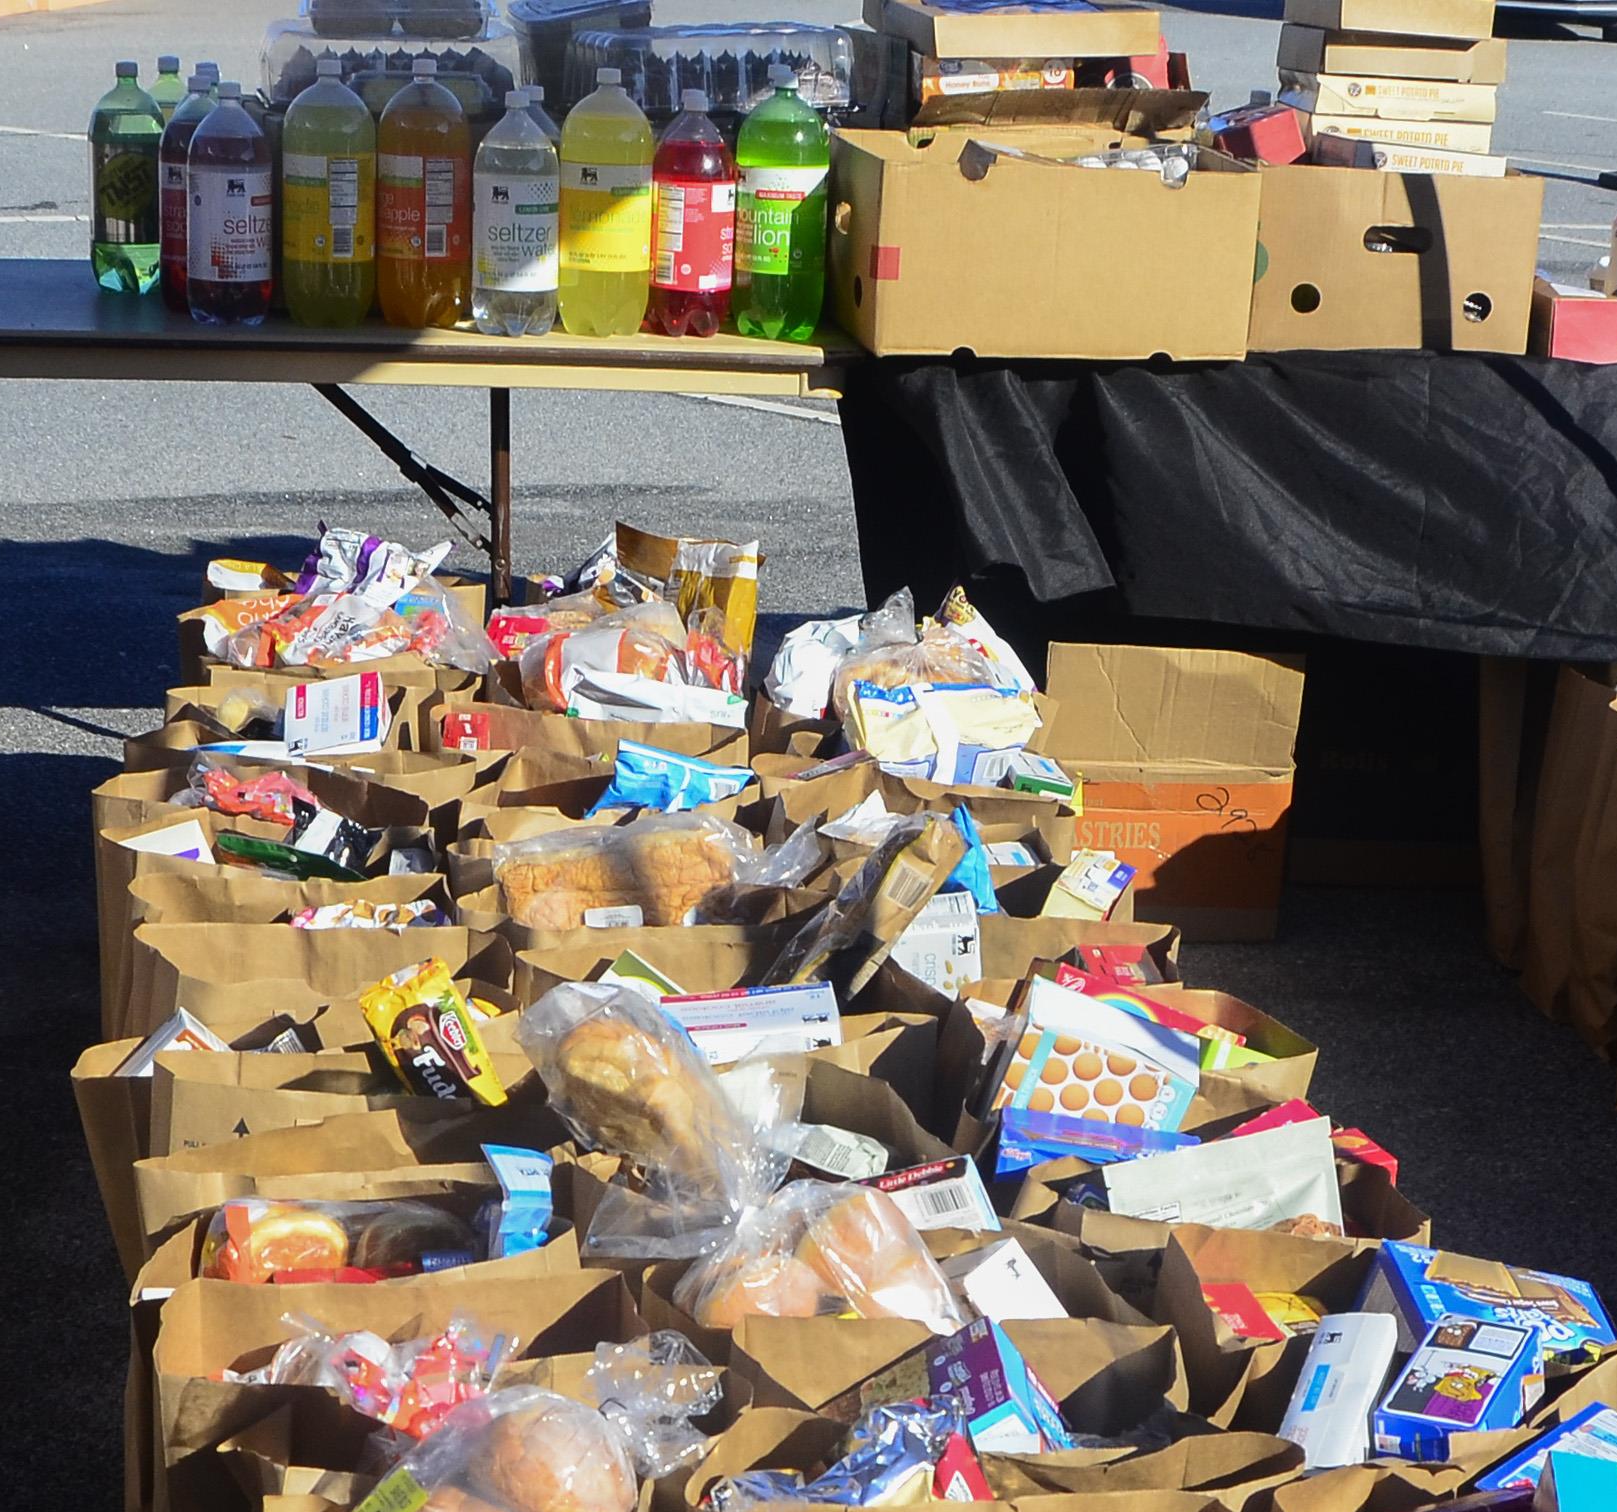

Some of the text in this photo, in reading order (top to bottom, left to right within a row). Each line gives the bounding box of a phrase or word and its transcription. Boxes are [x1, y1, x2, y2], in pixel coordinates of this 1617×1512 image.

[1391, 153, 1418, 167] SWEET
[1450, 160, 1465, 173] PIE
[487, 221, 553, 243] seltzer
[753, 225, 791, 247] lion
[1072, 821, 1161, 850] ASTRIES
